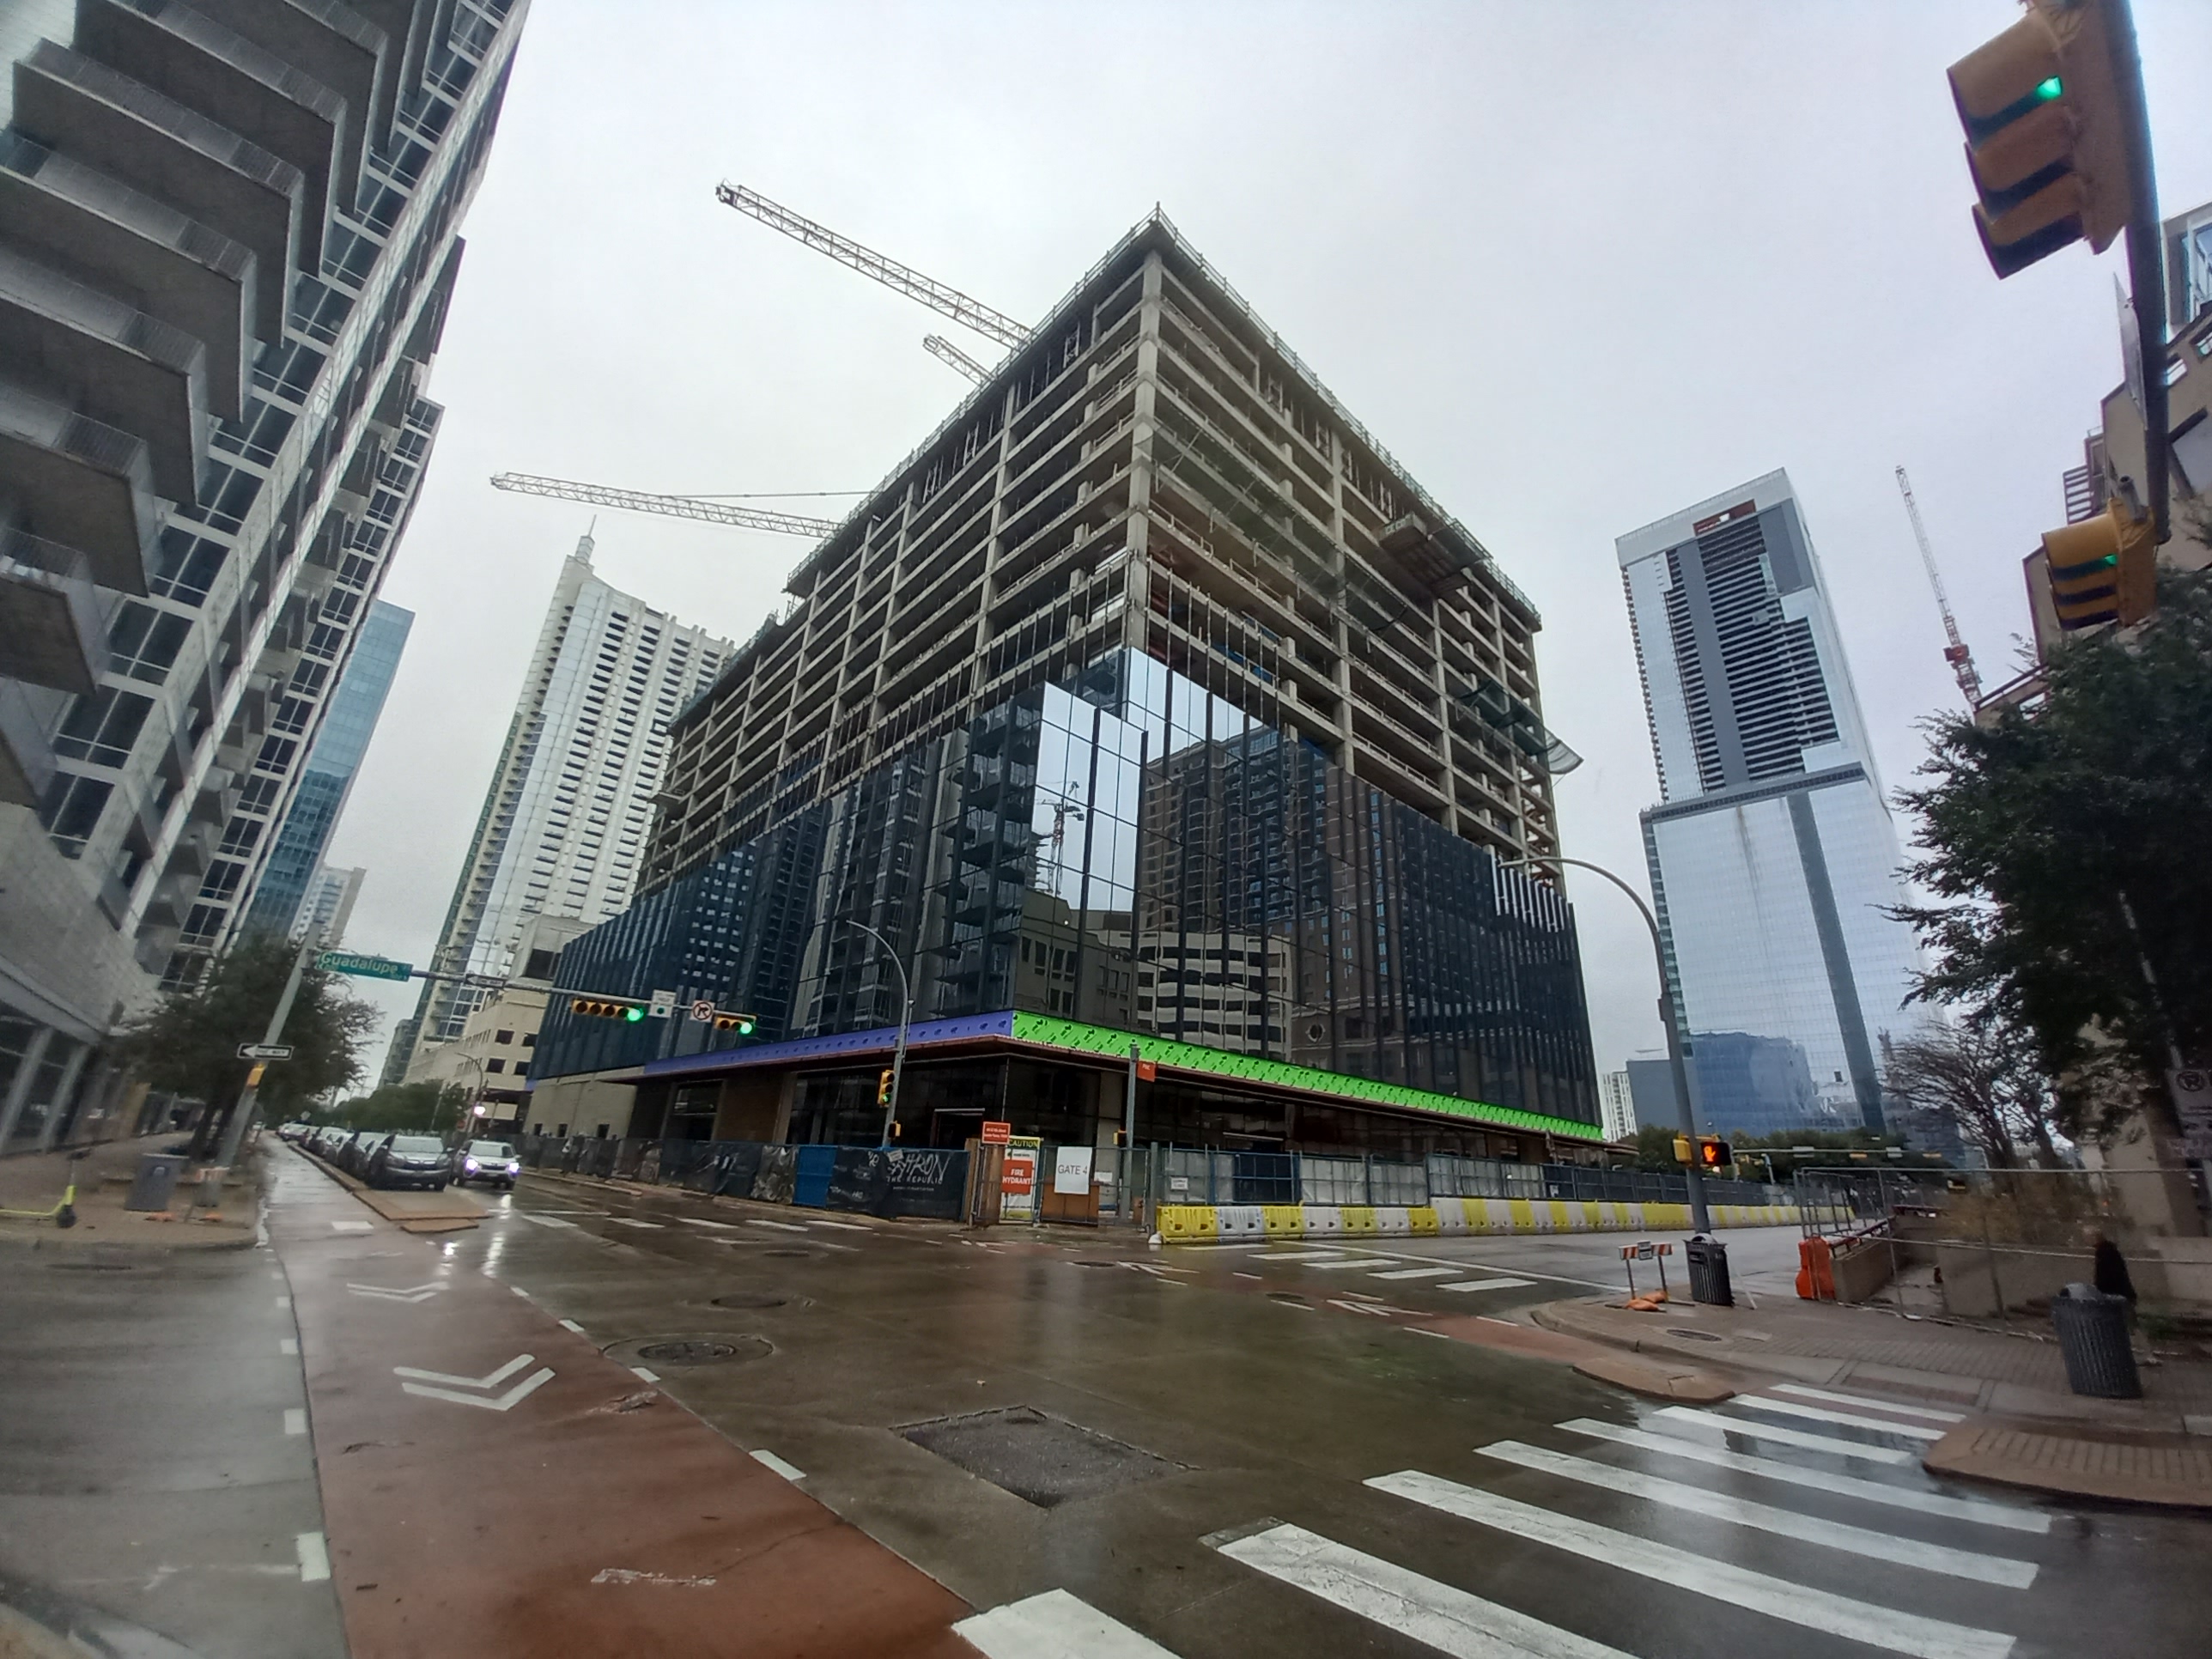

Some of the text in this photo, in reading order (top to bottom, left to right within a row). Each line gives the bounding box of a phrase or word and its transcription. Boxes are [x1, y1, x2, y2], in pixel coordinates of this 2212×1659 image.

[320, 951, 398, 975] Guadalupe
[1008, 1139, 1039, 1148] CAUTION
[1011, 1168, 1024, 1176] FIRE
[1057, 1164, 1088, 1176] GATE 4
[906, 1176, 943, 1184] EPULIC
[1002, 1176, 1031, 1185] HYDRANT
